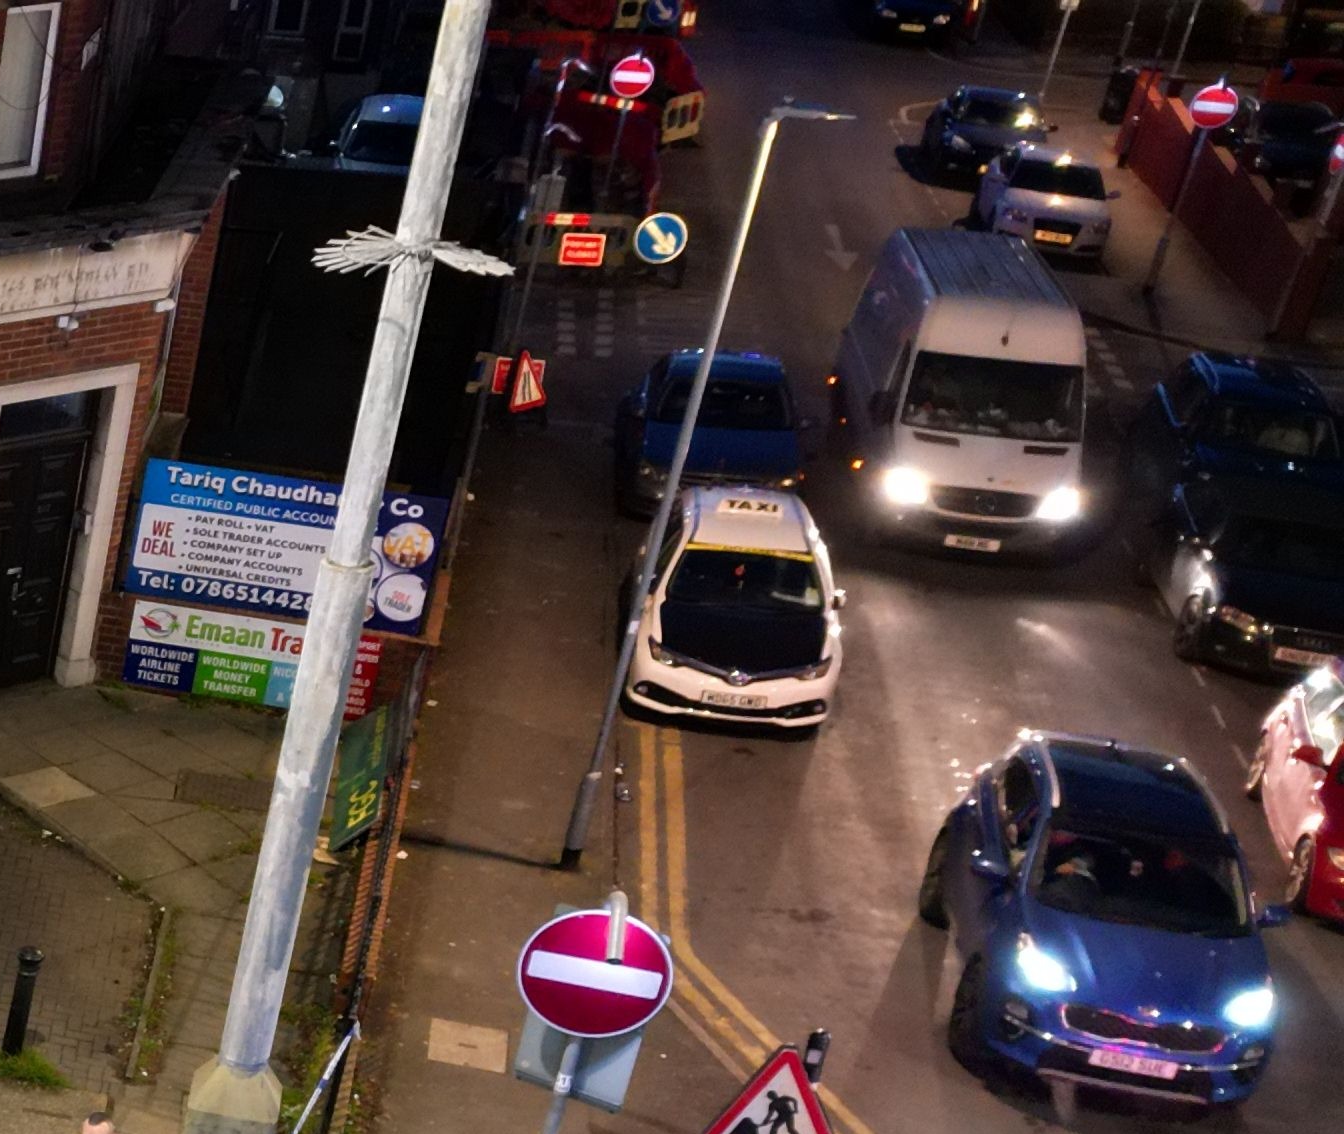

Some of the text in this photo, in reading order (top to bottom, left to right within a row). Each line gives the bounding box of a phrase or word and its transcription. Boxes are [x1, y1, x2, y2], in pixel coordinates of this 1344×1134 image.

[168, 466, 424, 518] Tariq Chaudha Co
[171, 493, 337, 526] CERTIFIED PUBLIC ACCOUN
[727, 499, 779, 513] TAXI
[152, 519, 174, 538] WE
[195, 515, 275, 533] PAY ROLL VAT
[141, 537, 176, 558] DEAL
[190, 539, 283, 560] COMPANY SET UP
[193, 527, 326, 554] SOLE TRADER ACCOUNTS
[188, 552, 302, 576] COMPANY ACCOUNTS
[138, 570, 174, 591] Tel:
[186, 564, 291, 587] UNIVERSAL CREDITS
[186, 615, 266, 649] Emaan
[271, 628, 304, 655] Tra
[131, 644, 195, 663] WORLDWIDE
[139, 658, 181, 673] AIRLINE
[202, 655, 267, 674] WORLDWIDE
[137, 669, 179, 686] TICKETS
[214, 669, 251, 684] MONEY
[203, 680, 256, 697] TRANSFER
